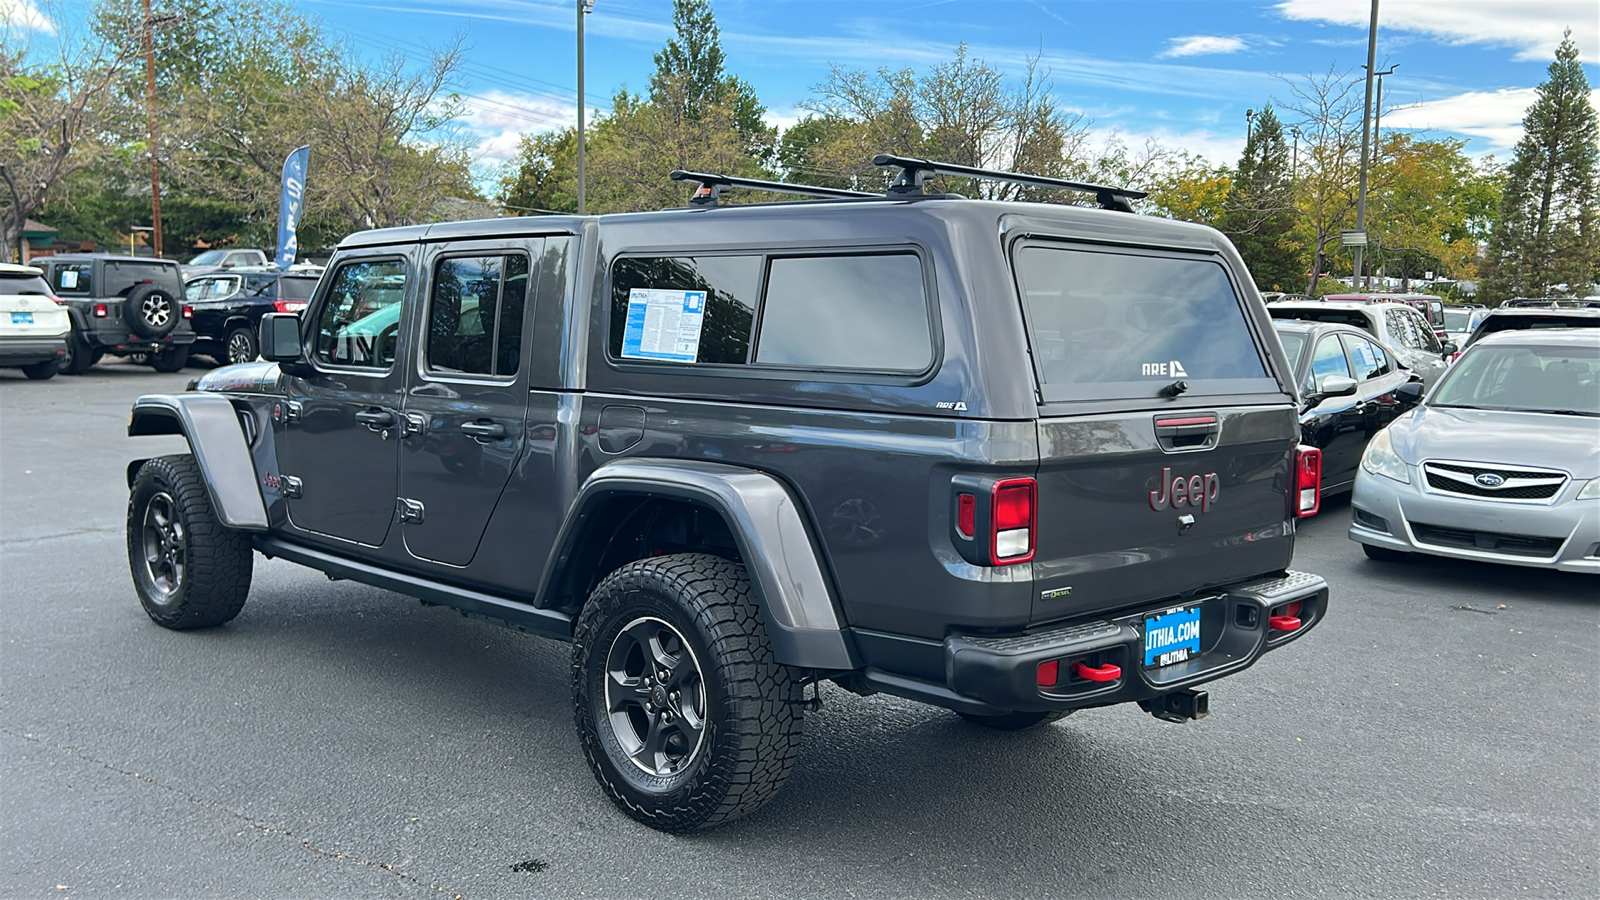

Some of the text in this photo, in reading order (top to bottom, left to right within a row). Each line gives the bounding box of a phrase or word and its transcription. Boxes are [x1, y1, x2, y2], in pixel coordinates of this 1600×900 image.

[1142, 363, 1168, 376] ARE
[936, 401, 955, 409] ARE
[263, 471, 281, 492] Jeep
[1149, 467, 1220, 514] Jeep
[1167, 648, 1189, 665] LITHIA
